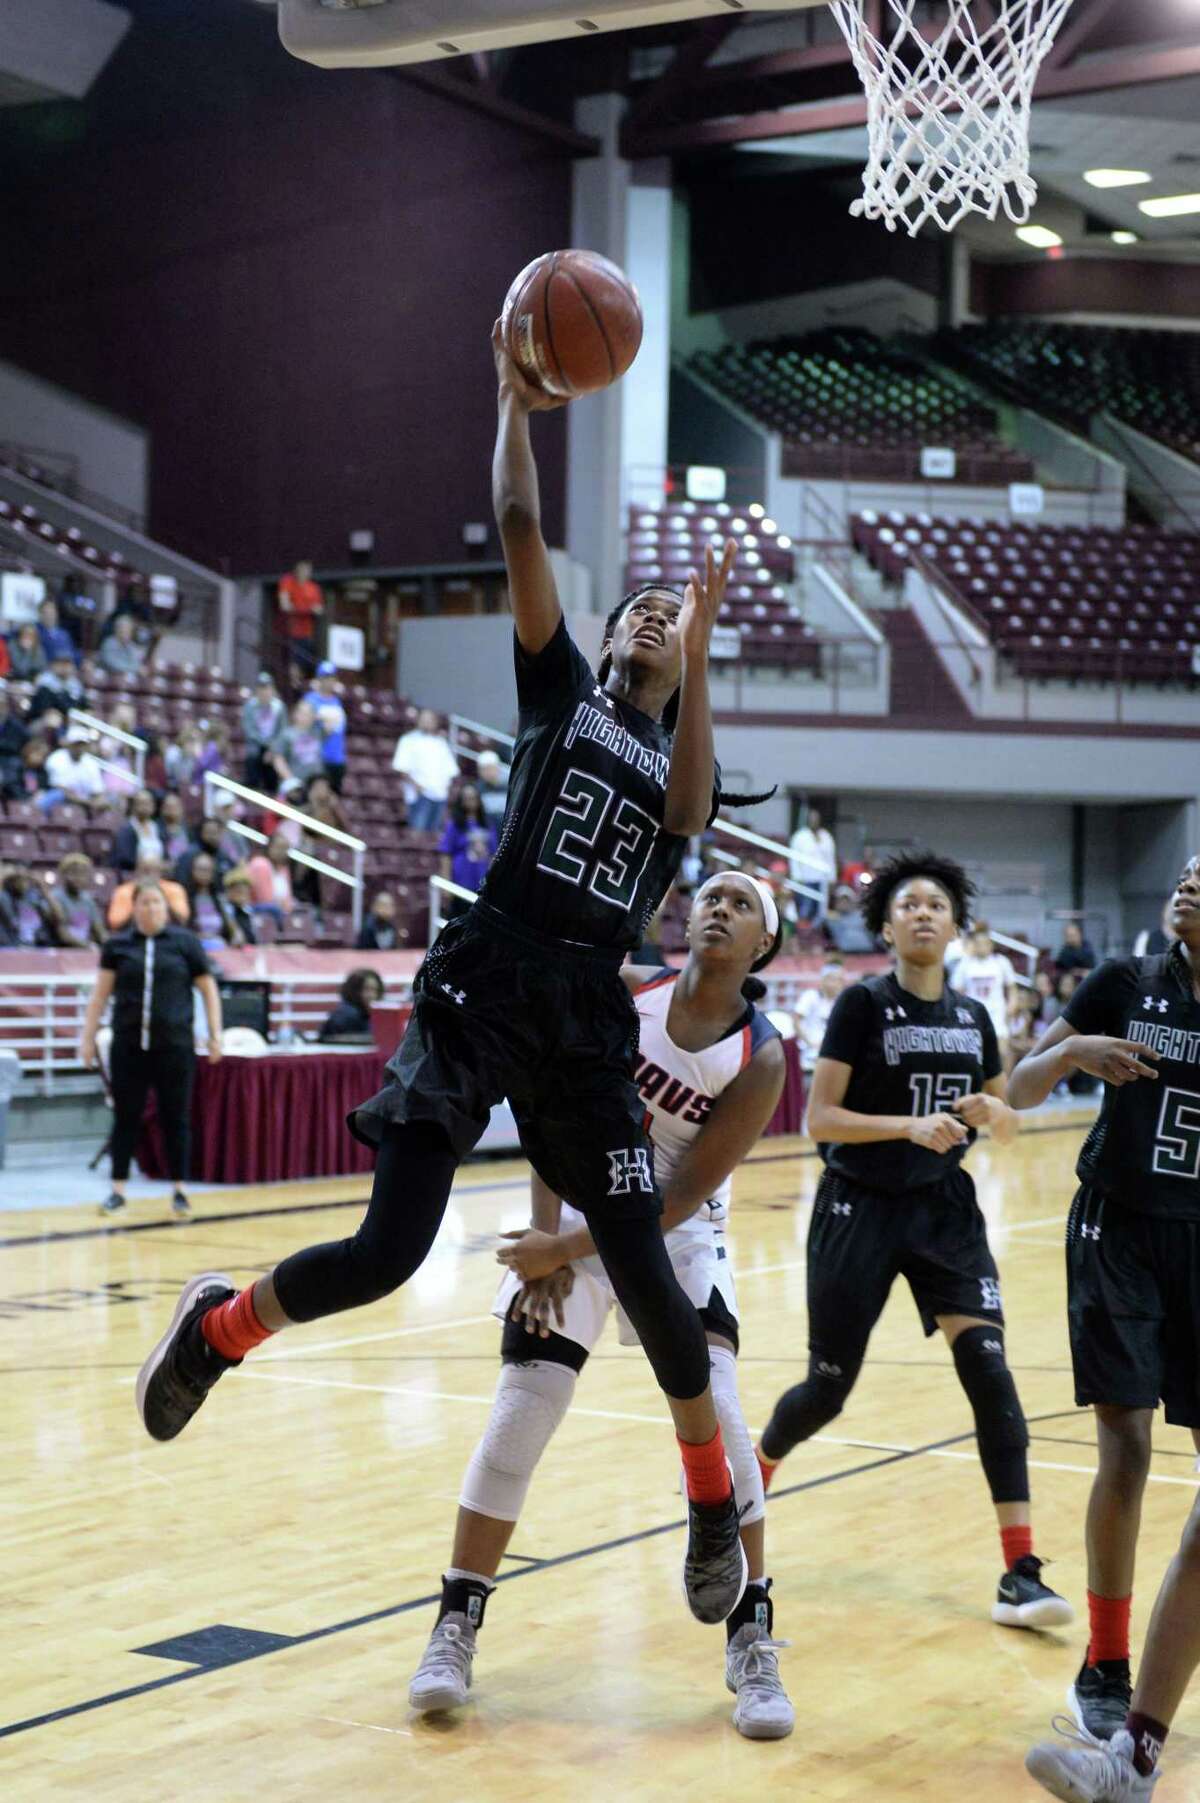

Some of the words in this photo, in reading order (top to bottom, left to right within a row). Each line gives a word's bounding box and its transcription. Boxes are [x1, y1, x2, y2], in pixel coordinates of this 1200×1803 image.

[537, 768, 661, 911] 23
[1127, 1020, 1200, 1064] HIGHT
[909, 1073, 972, 1117] 12
[1152, 1087, 1200, 1179] 5
